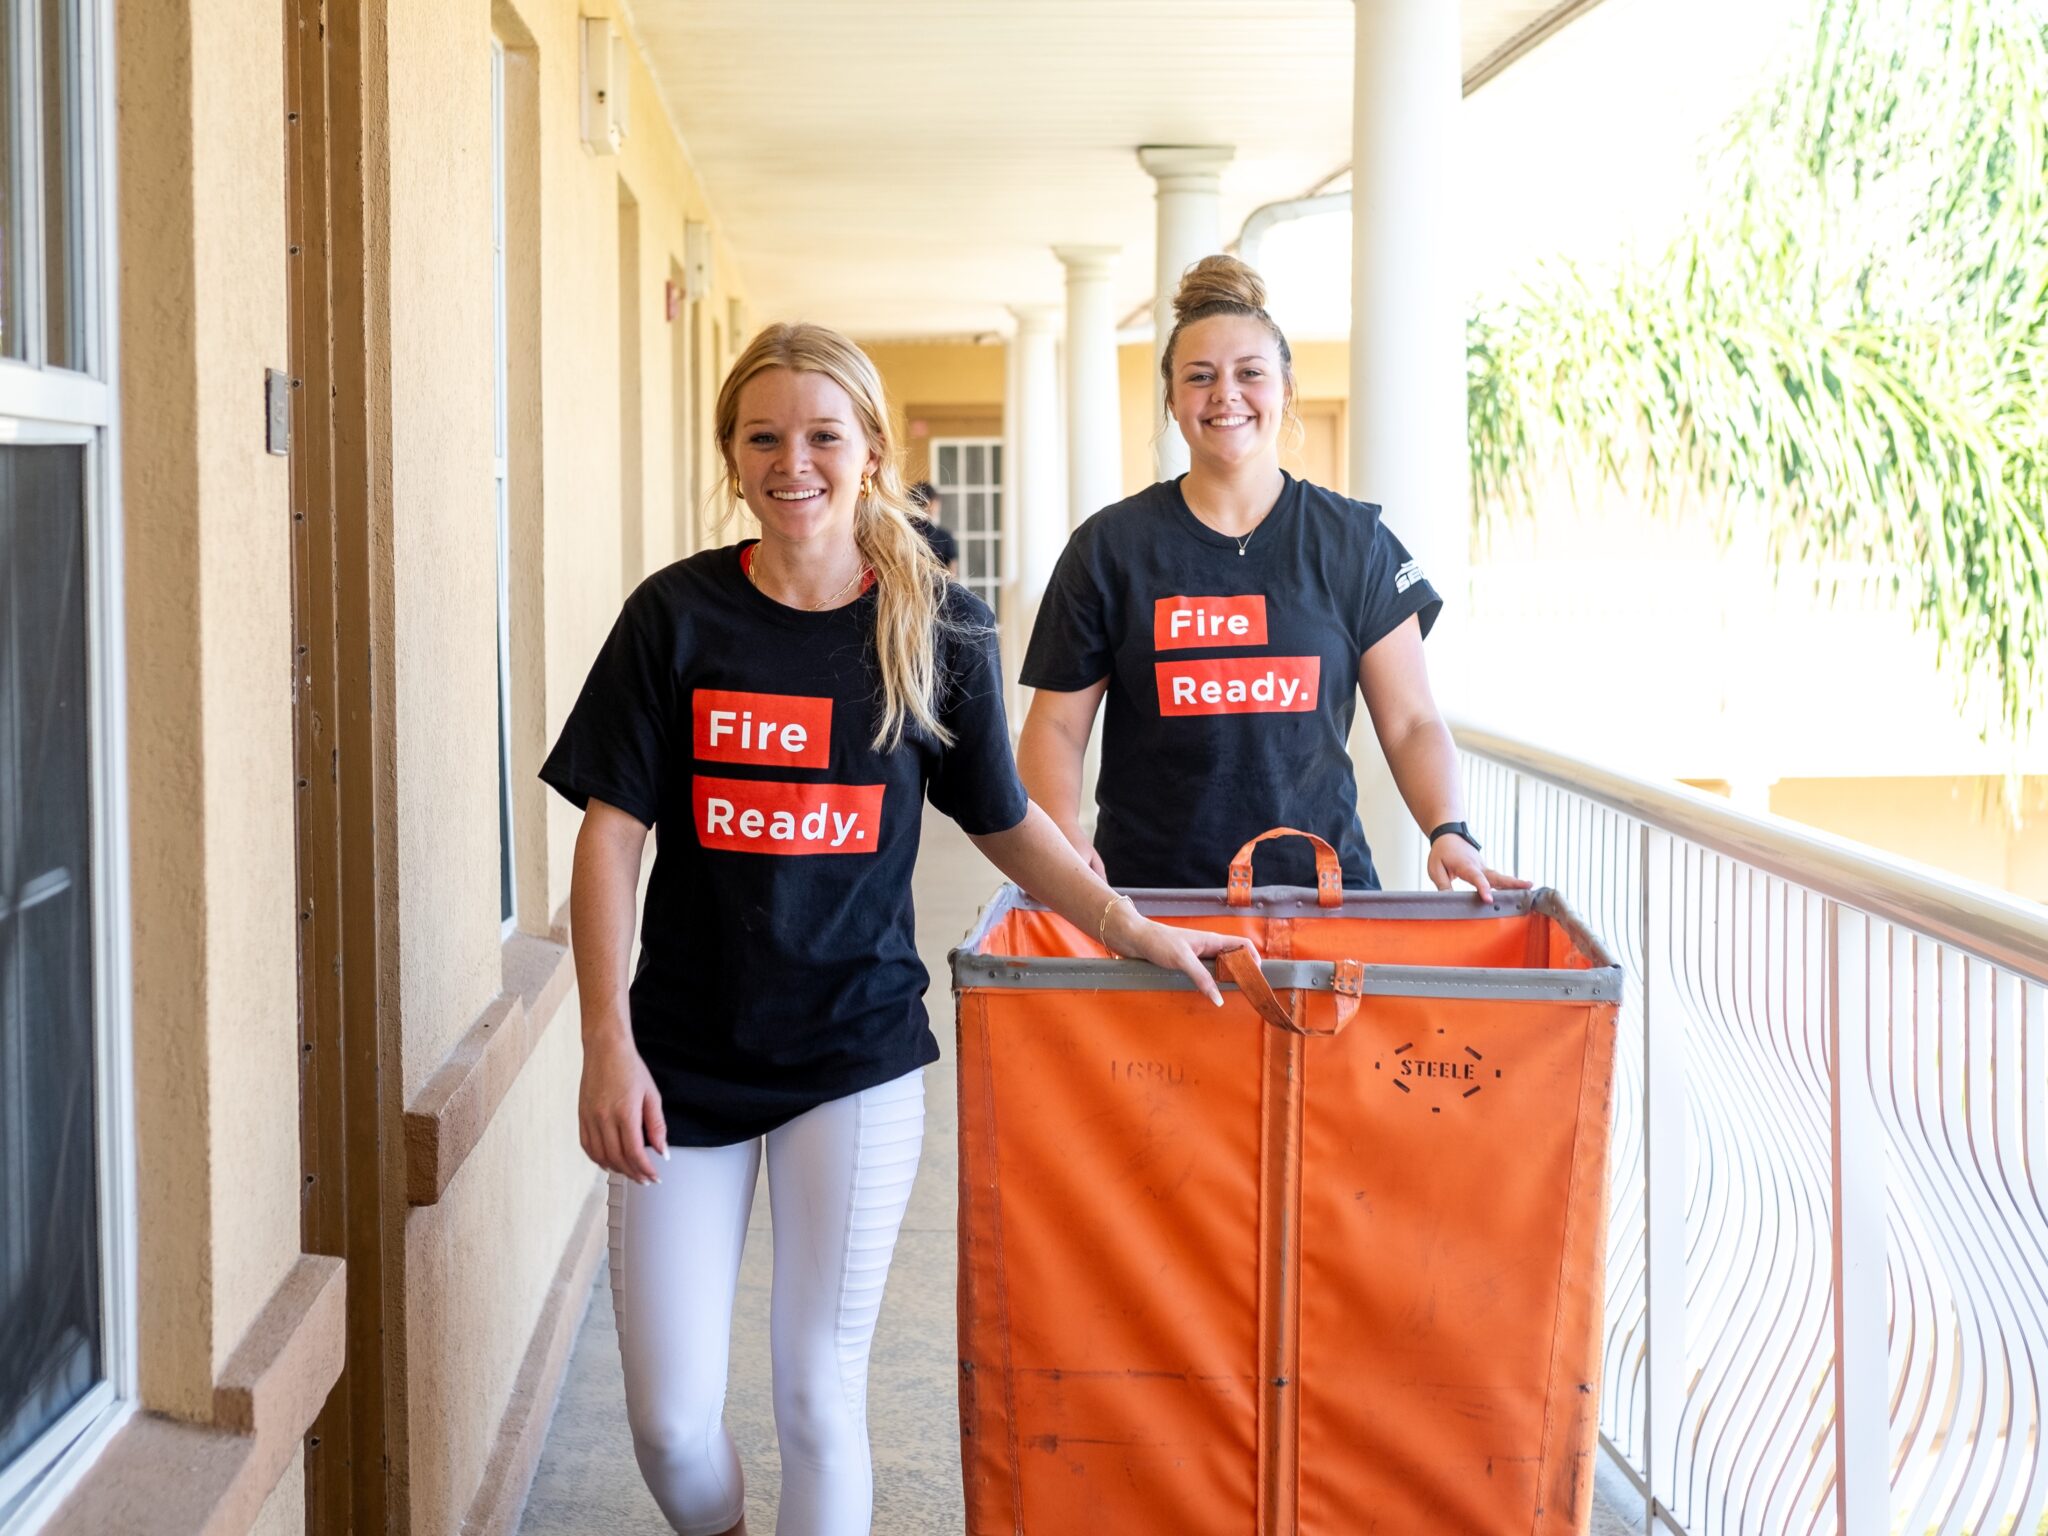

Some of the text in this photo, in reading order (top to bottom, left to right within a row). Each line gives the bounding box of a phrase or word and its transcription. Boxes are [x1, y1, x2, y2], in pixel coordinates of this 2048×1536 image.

[1170, 608, 1250, 638] Fire
[1171, 671, 1309, 707] Ready.
[709, 710, 808, 753] Fire
[707, 797, 865, 847] Ready.
[1401, 1059, 1475, 1080] STEELE
